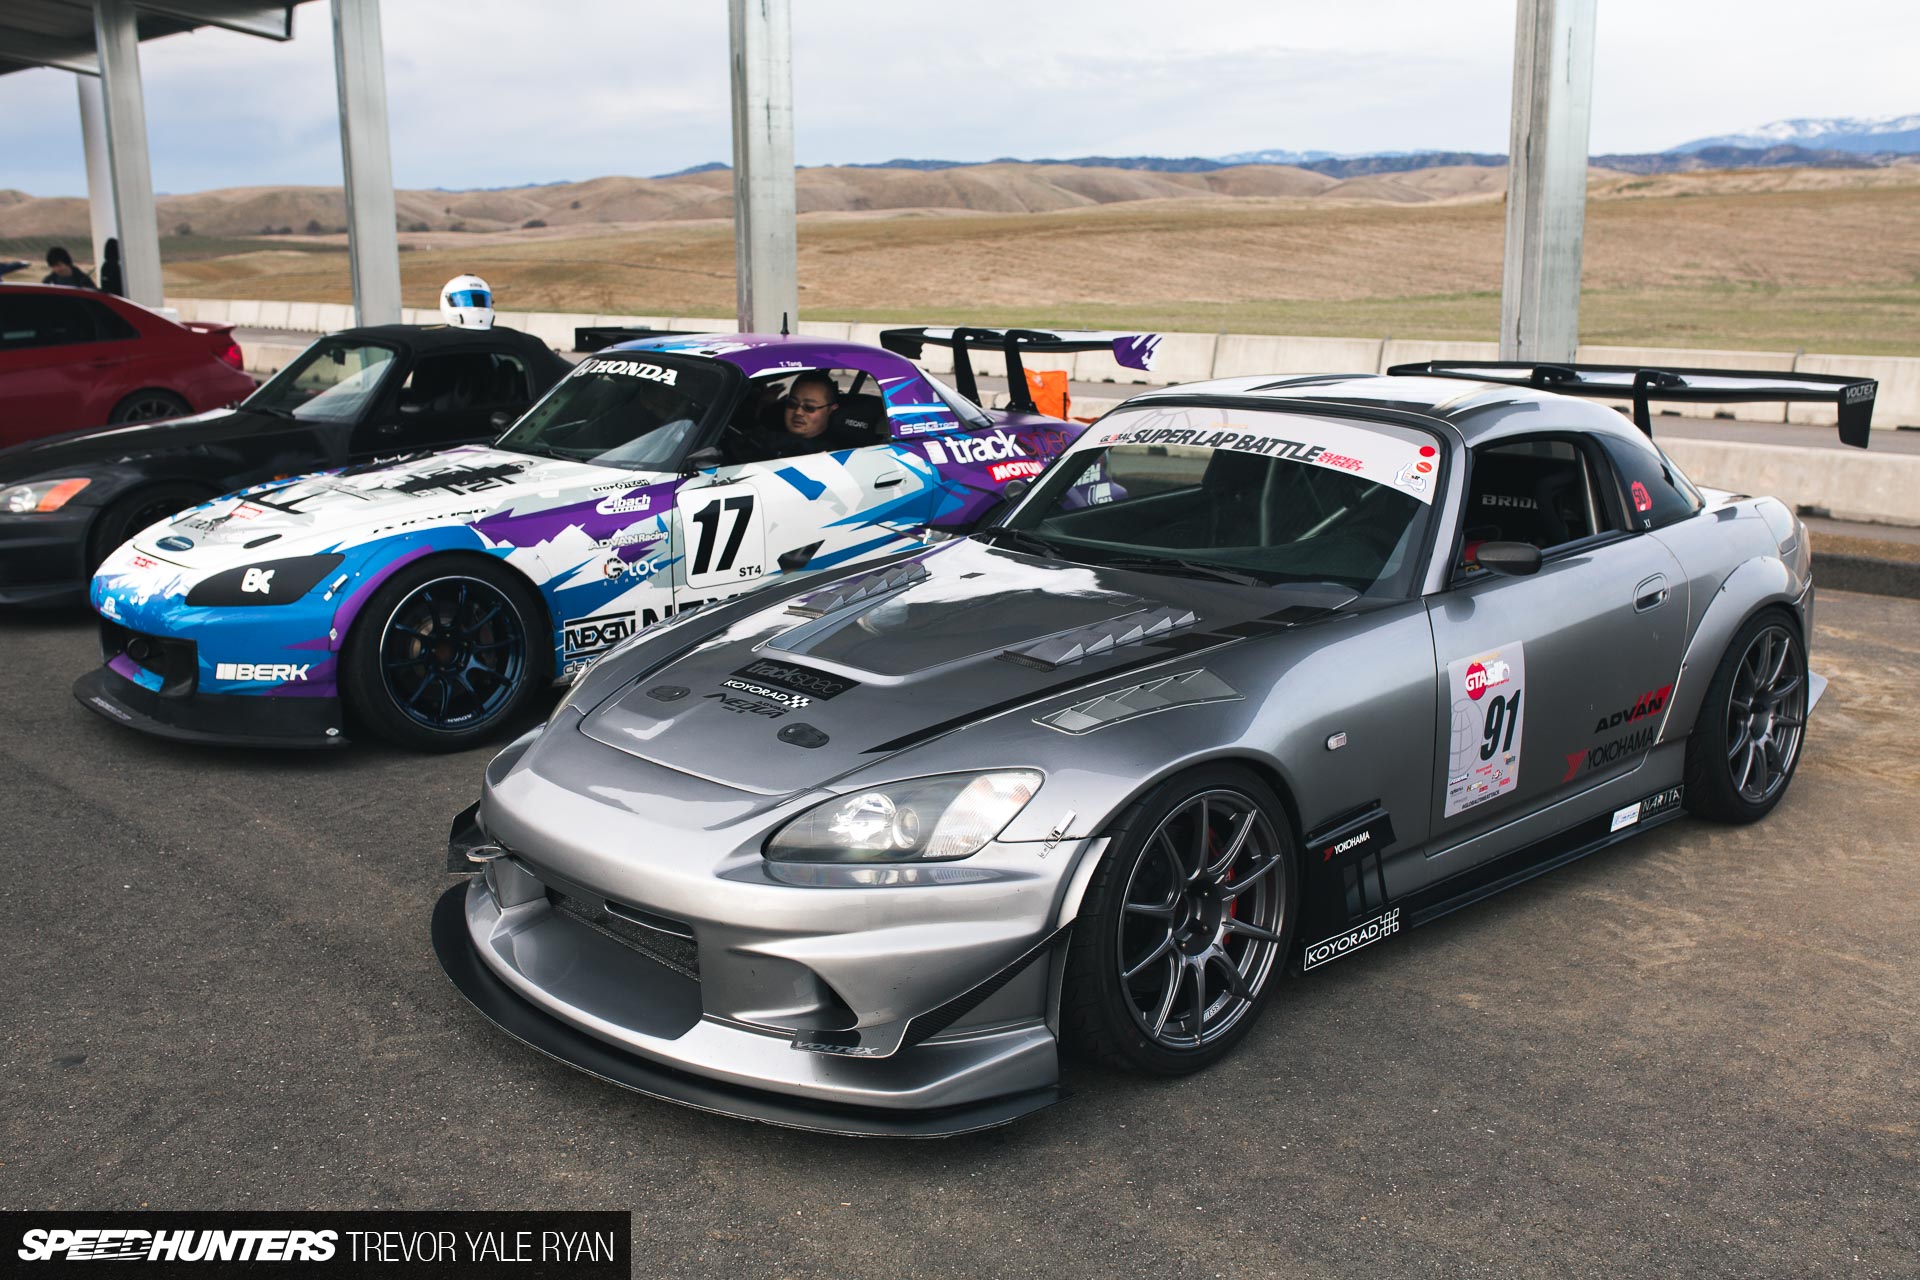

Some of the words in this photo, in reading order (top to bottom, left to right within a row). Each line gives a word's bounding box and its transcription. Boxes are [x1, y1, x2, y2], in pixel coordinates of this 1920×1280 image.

[590, 359, 678, 386] HONDA
[1846, 383, 1875, 398] VOLTEX
[1130, 429, 1198, 446] SUPER
[1195, 431, 1240, 448] LAP
[1232, 435, 1327, 463] BATTLE
[1316, 457, 1366, 472] STREET
[1323, 452, 1364, 465] SUPER
[588, 536, 639, 551] ADVAN
[639, 530, 669, 542] Racing
[692, 495, 754, 575] 17
[739, 565, 761, 577] ST4
[237, 663, 310, 681] BERK
[723, 679, 789, 702] KOYORAD
[756, 701, 790, 713] ADVAN
[1594, 697, 1663, 735] ADVAN
[1480, 689, 1521, 761] 91
[1587, 727, 1655, 770] YOKOHAMA
[1642, 789, 1681, 813] NARITA
[1334, 830, 1371, 855] YOKOHAMA
[1307, 924, 1379, 965] KOYORAD
[796, 1041, 880, 1056] VOLTEX
